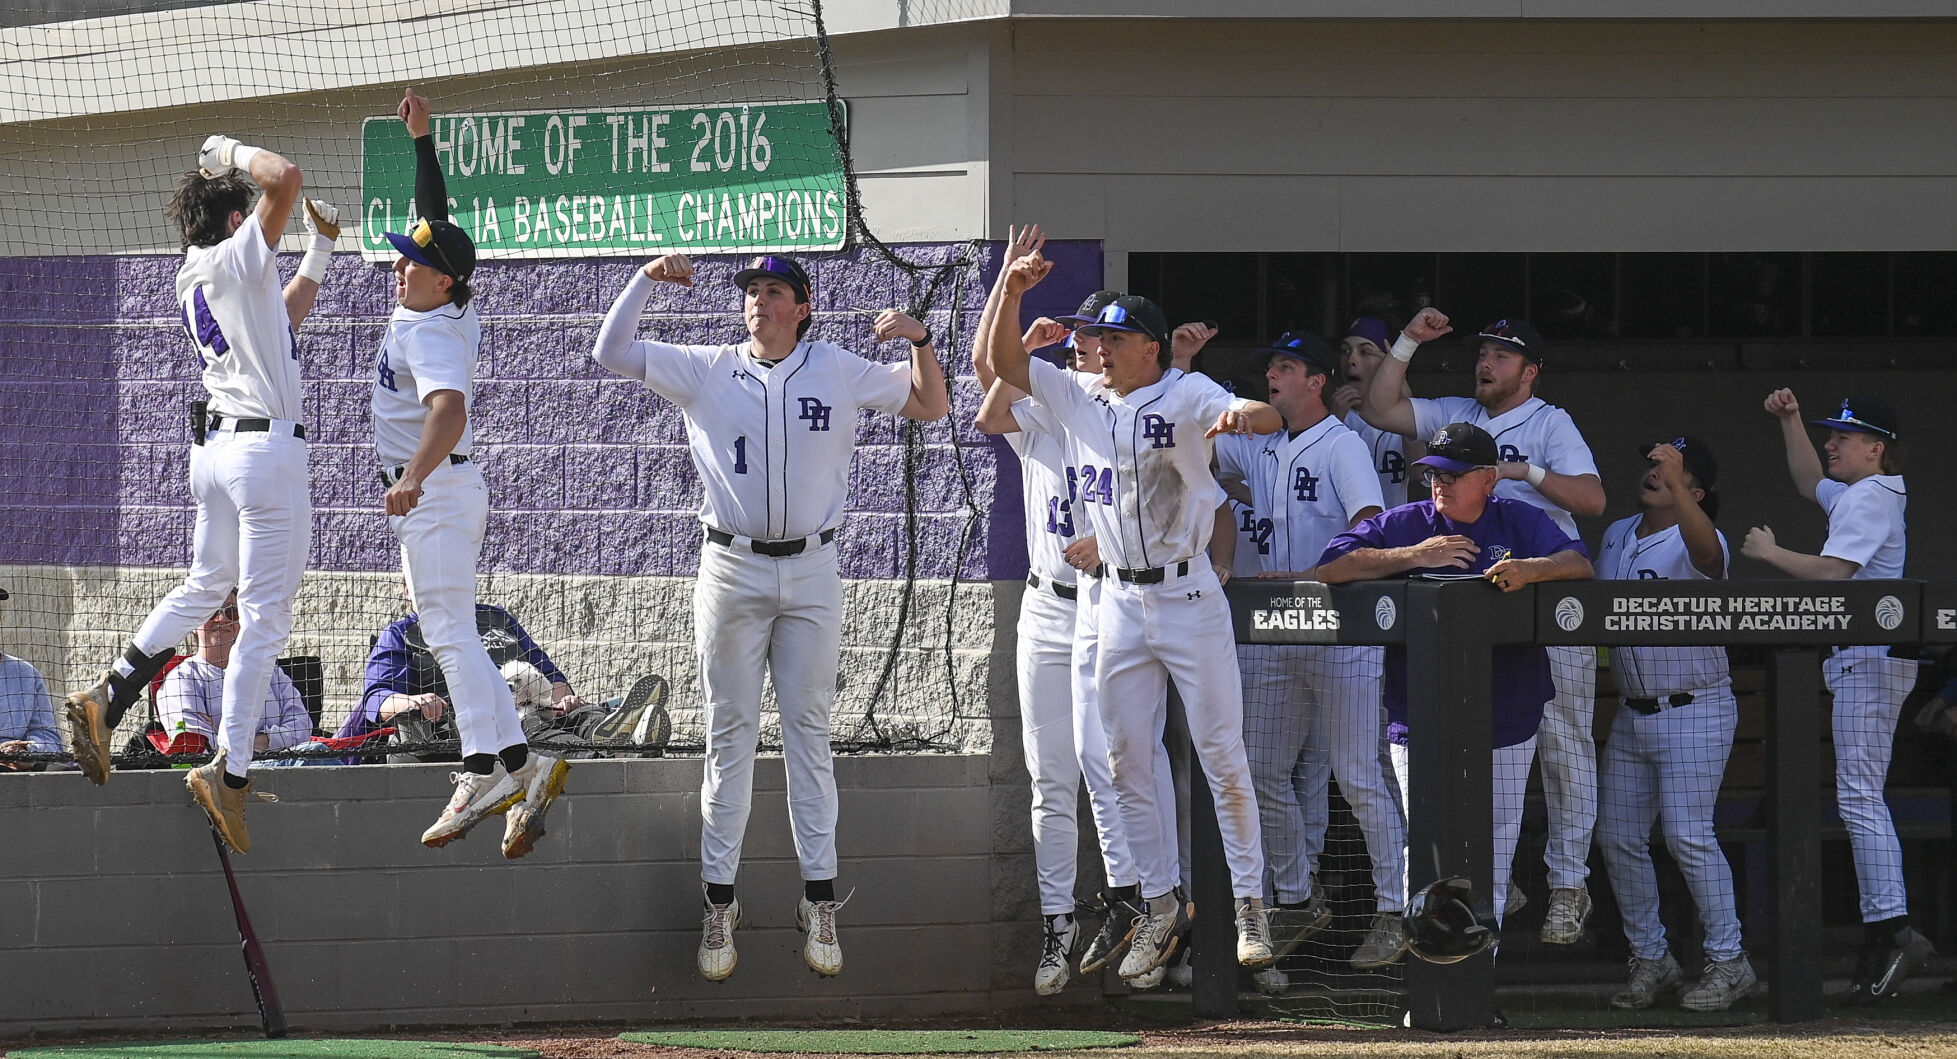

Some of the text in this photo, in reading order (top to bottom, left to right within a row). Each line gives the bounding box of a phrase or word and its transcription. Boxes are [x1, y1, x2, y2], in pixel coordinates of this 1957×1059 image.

[434, 111, 772, 176] HOME OF THE 2016
[473, 196, 500, 243] 1A
[514, 194, 663, 243] BASEBALL
[677, 189, 839, 241] CHAMPIONS
[797, 397, 832, 431] DH
[1142, 413, 1176, 449] DH
[733, 436, 748, 474] 1
[1080, 464, 1113, 506] 24
[1293, 466, 1319, 502] DH
[1047, 495, 1076, 538] 13
[1253, 609, 1340, 630] EAGLES
[1270, 597, 1322, 608] HOME OF THE
[1613, 597, 1845, 613] DECATUR HERITAGE
[1605, 614, 1853, 631] CHRISTIAN ACADEMY
